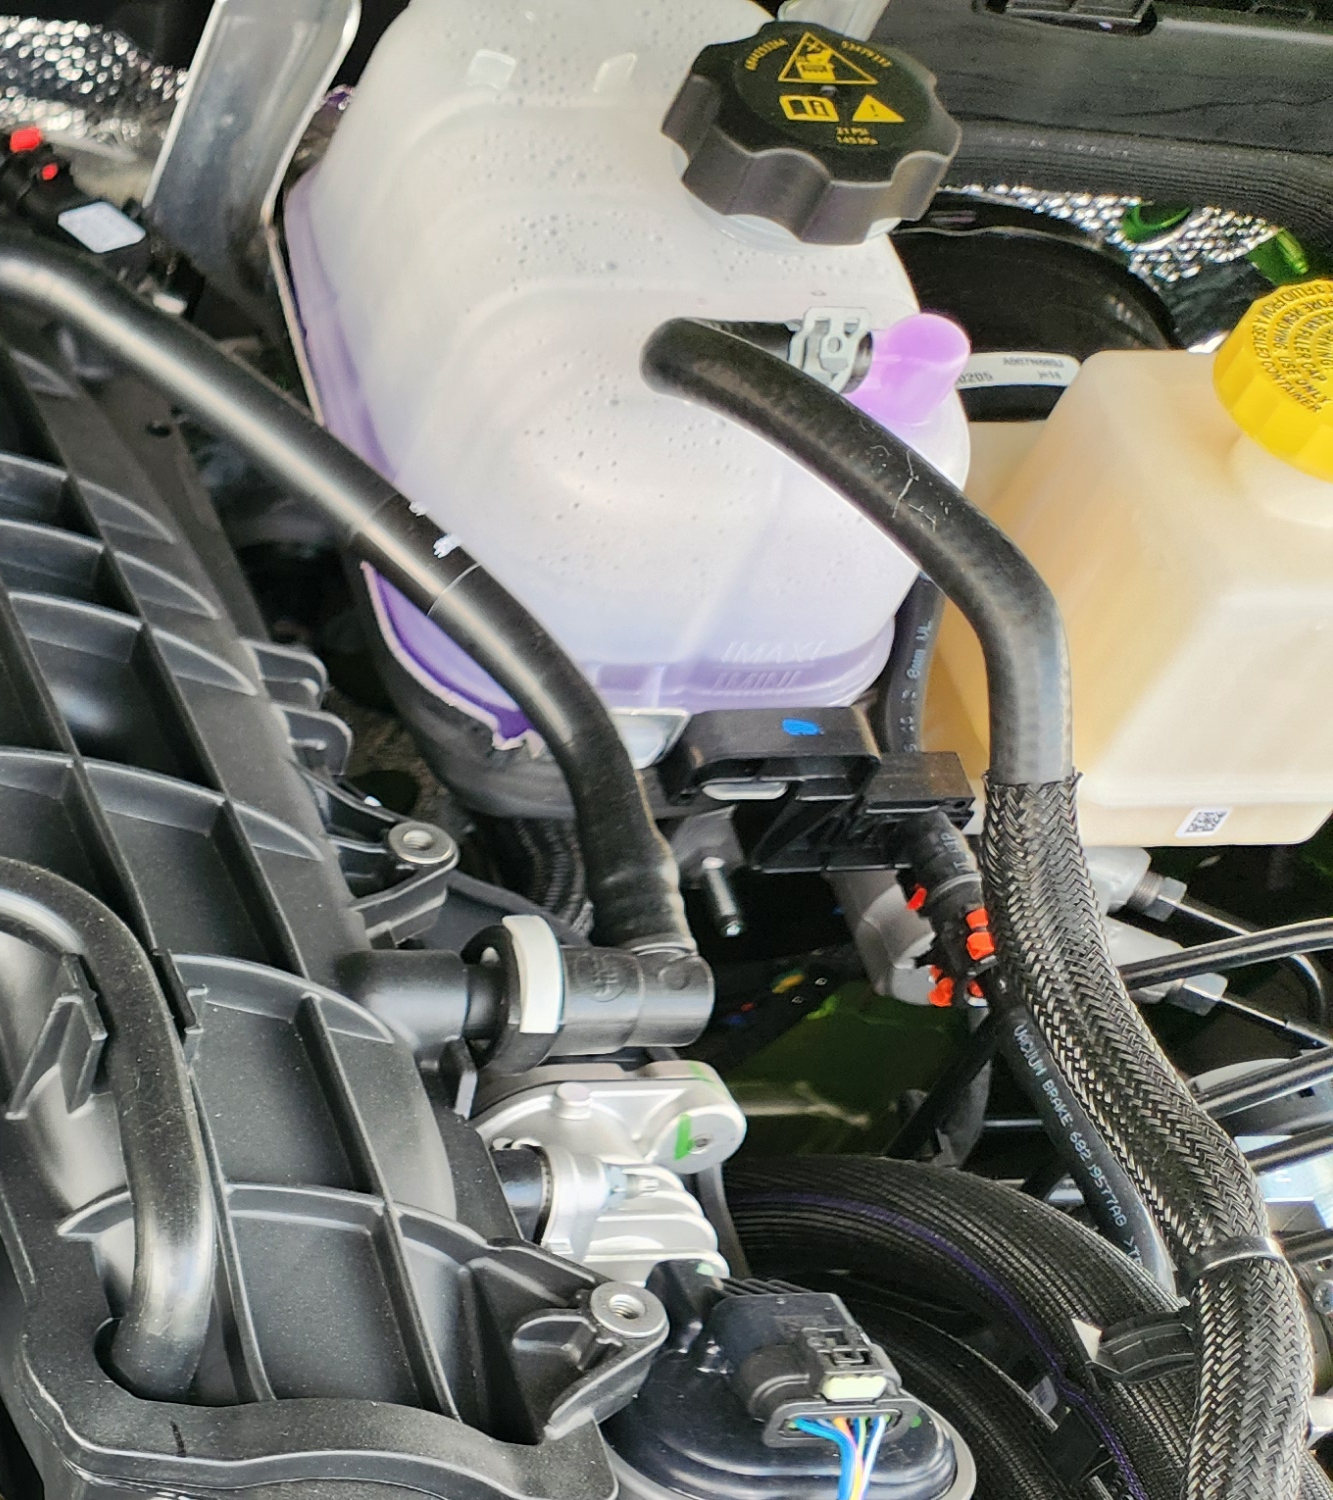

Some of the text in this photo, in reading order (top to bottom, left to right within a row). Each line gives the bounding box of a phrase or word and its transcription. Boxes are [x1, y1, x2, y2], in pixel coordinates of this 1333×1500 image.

[1261, 297, 1286, 318] FROM
[1280, 286, 1316, 302] FLUID
[1252, 325, 1271, 359] SEALED
[1294, 328, 1313, 359] FILLER
[1262, 361, 1322, 413] CONTAINER
[1278, 357, 1302, 378] USE
[1296, 378, 1332, 404] ONLY
[1301, 362, 1328, 382] CAP
[1039, 1077, 1076, 1128] BRAKE
